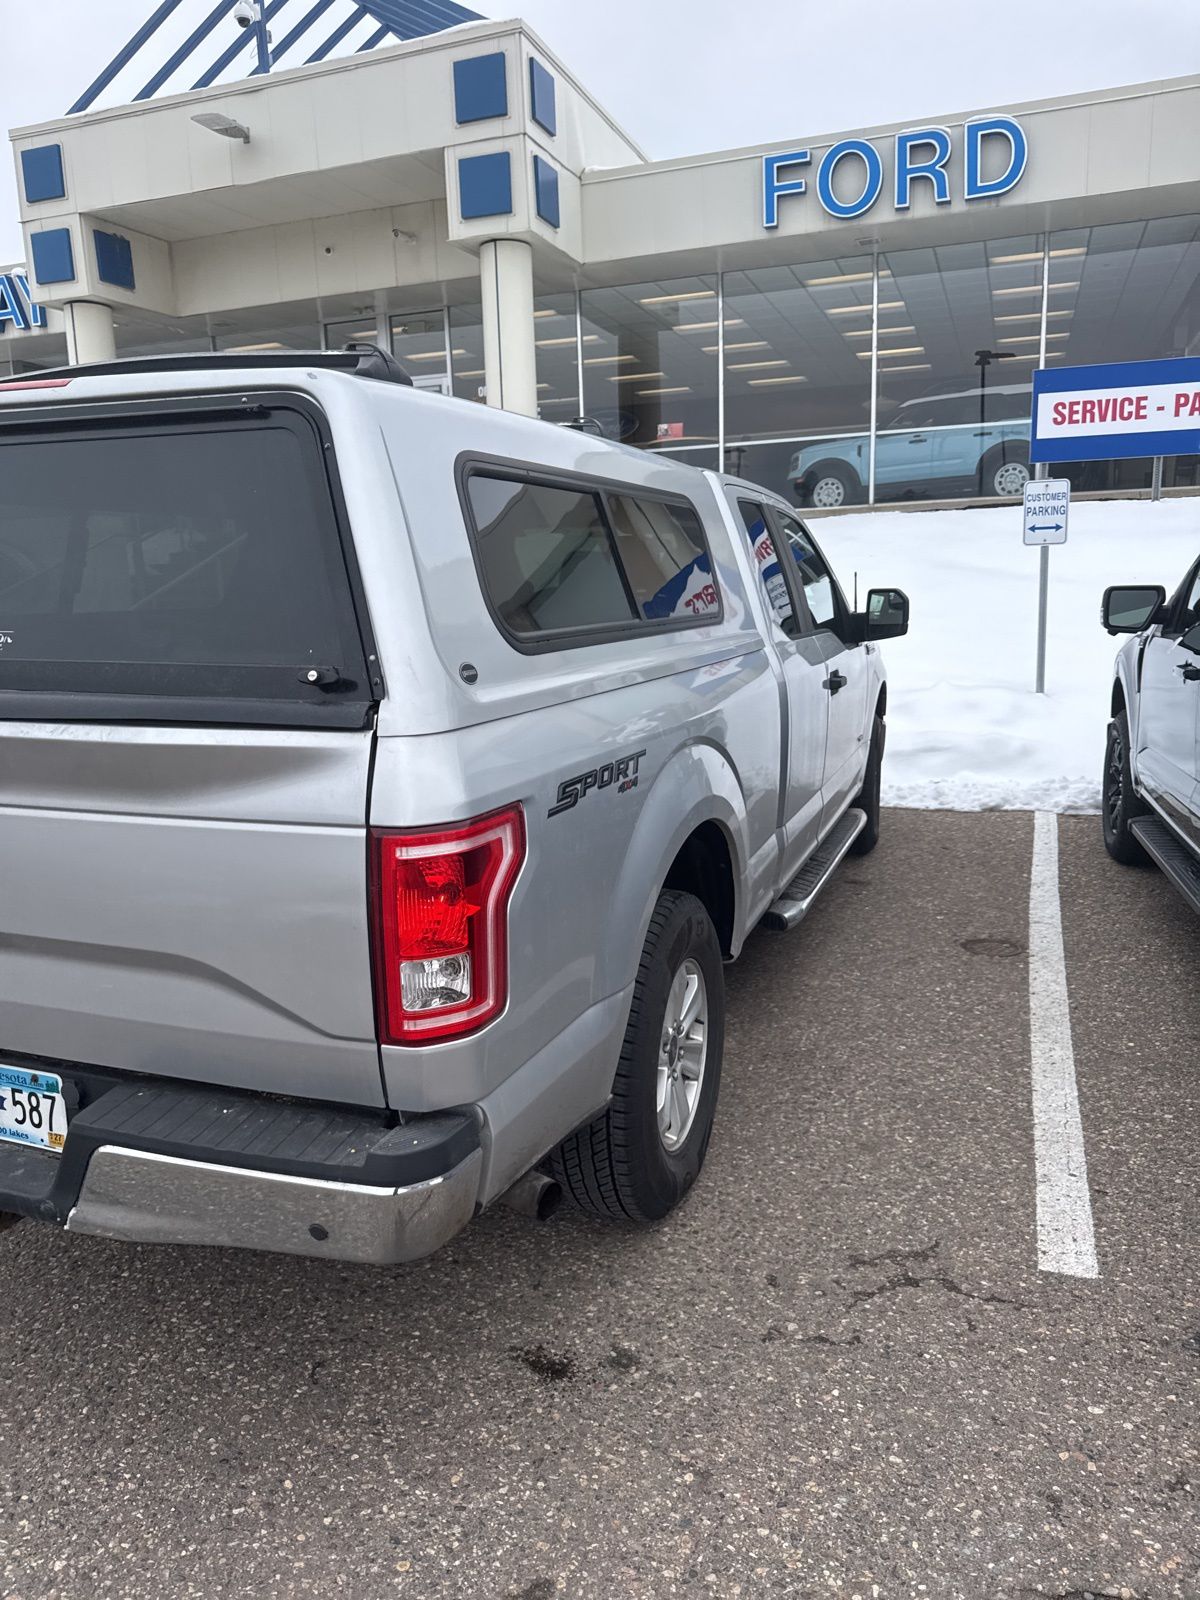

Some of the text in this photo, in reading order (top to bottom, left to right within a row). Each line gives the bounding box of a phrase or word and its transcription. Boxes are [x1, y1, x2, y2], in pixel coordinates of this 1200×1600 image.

[762, 117, 1028, 228] FORD
[1052, 396, 1149, 426] SERVICE
[1026, 491, 1067, 502] CUSTOMER
[1026, 505, 1066, 517] PARKING
[547, 748, 647, 819] SPORT
[11, 1088, 56, 1132] 587
[9, 1128, 29, 1140] lakes
